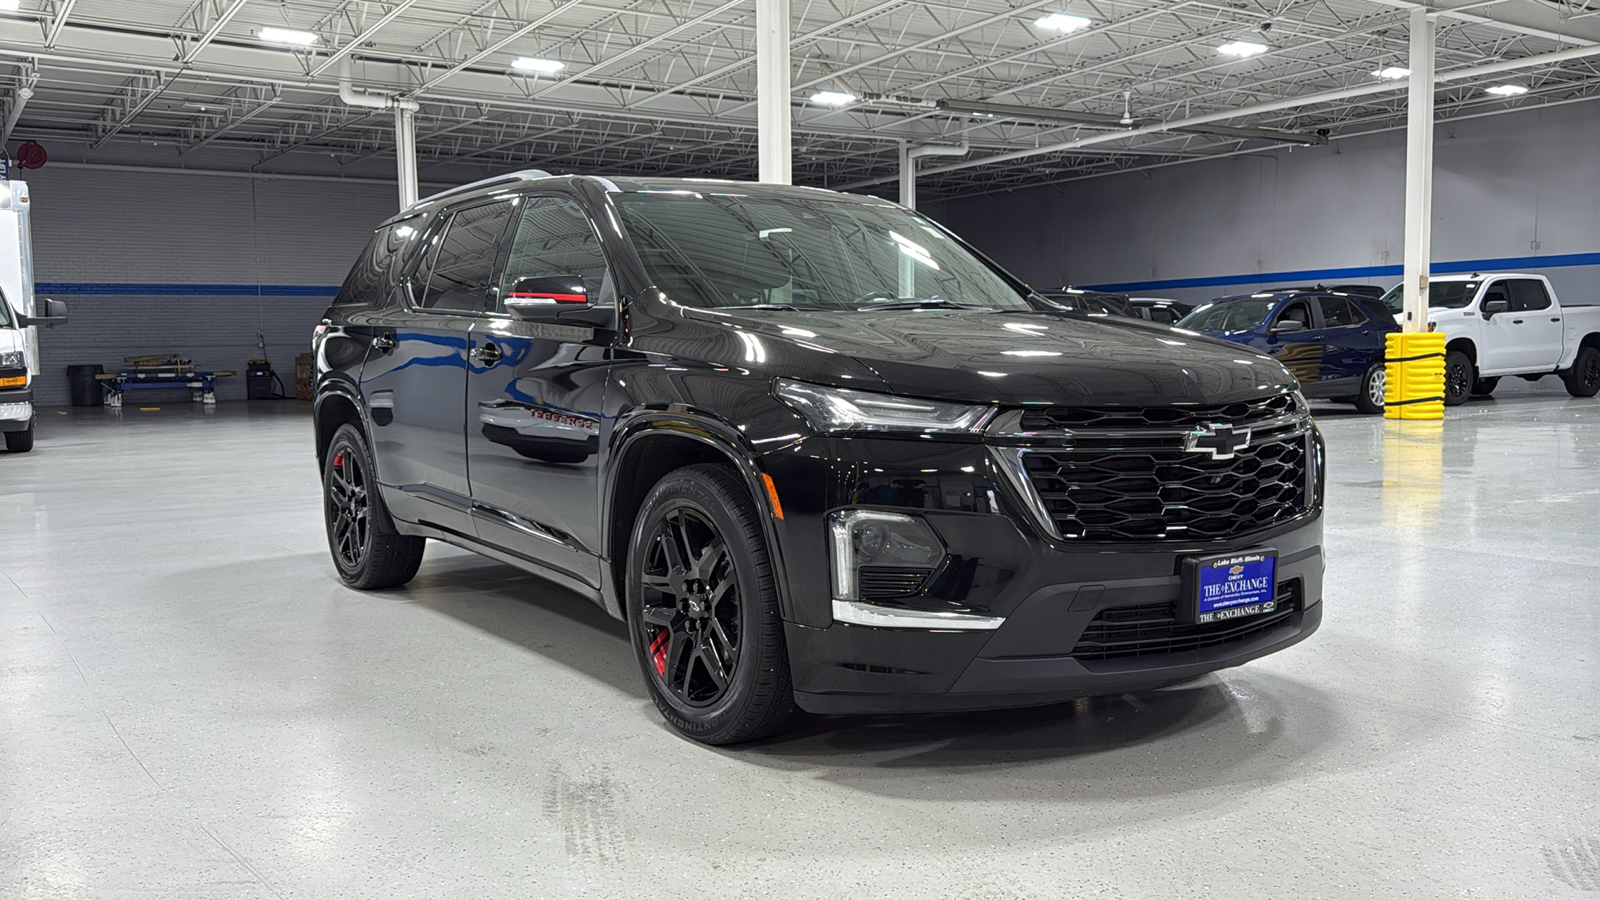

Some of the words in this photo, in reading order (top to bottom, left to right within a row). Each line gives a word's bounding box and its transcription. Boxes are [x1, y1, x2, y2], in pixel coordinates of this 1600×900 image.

[1204, 584, 1221, 597] THE
[1224, 577, 1268, 593] EXCHANGE
[1200, 613, 1214, 622] THE
[1220, 605, 1260, 619] EXCHANGE
[652, 692, 728, 732] CONTINENTAL
